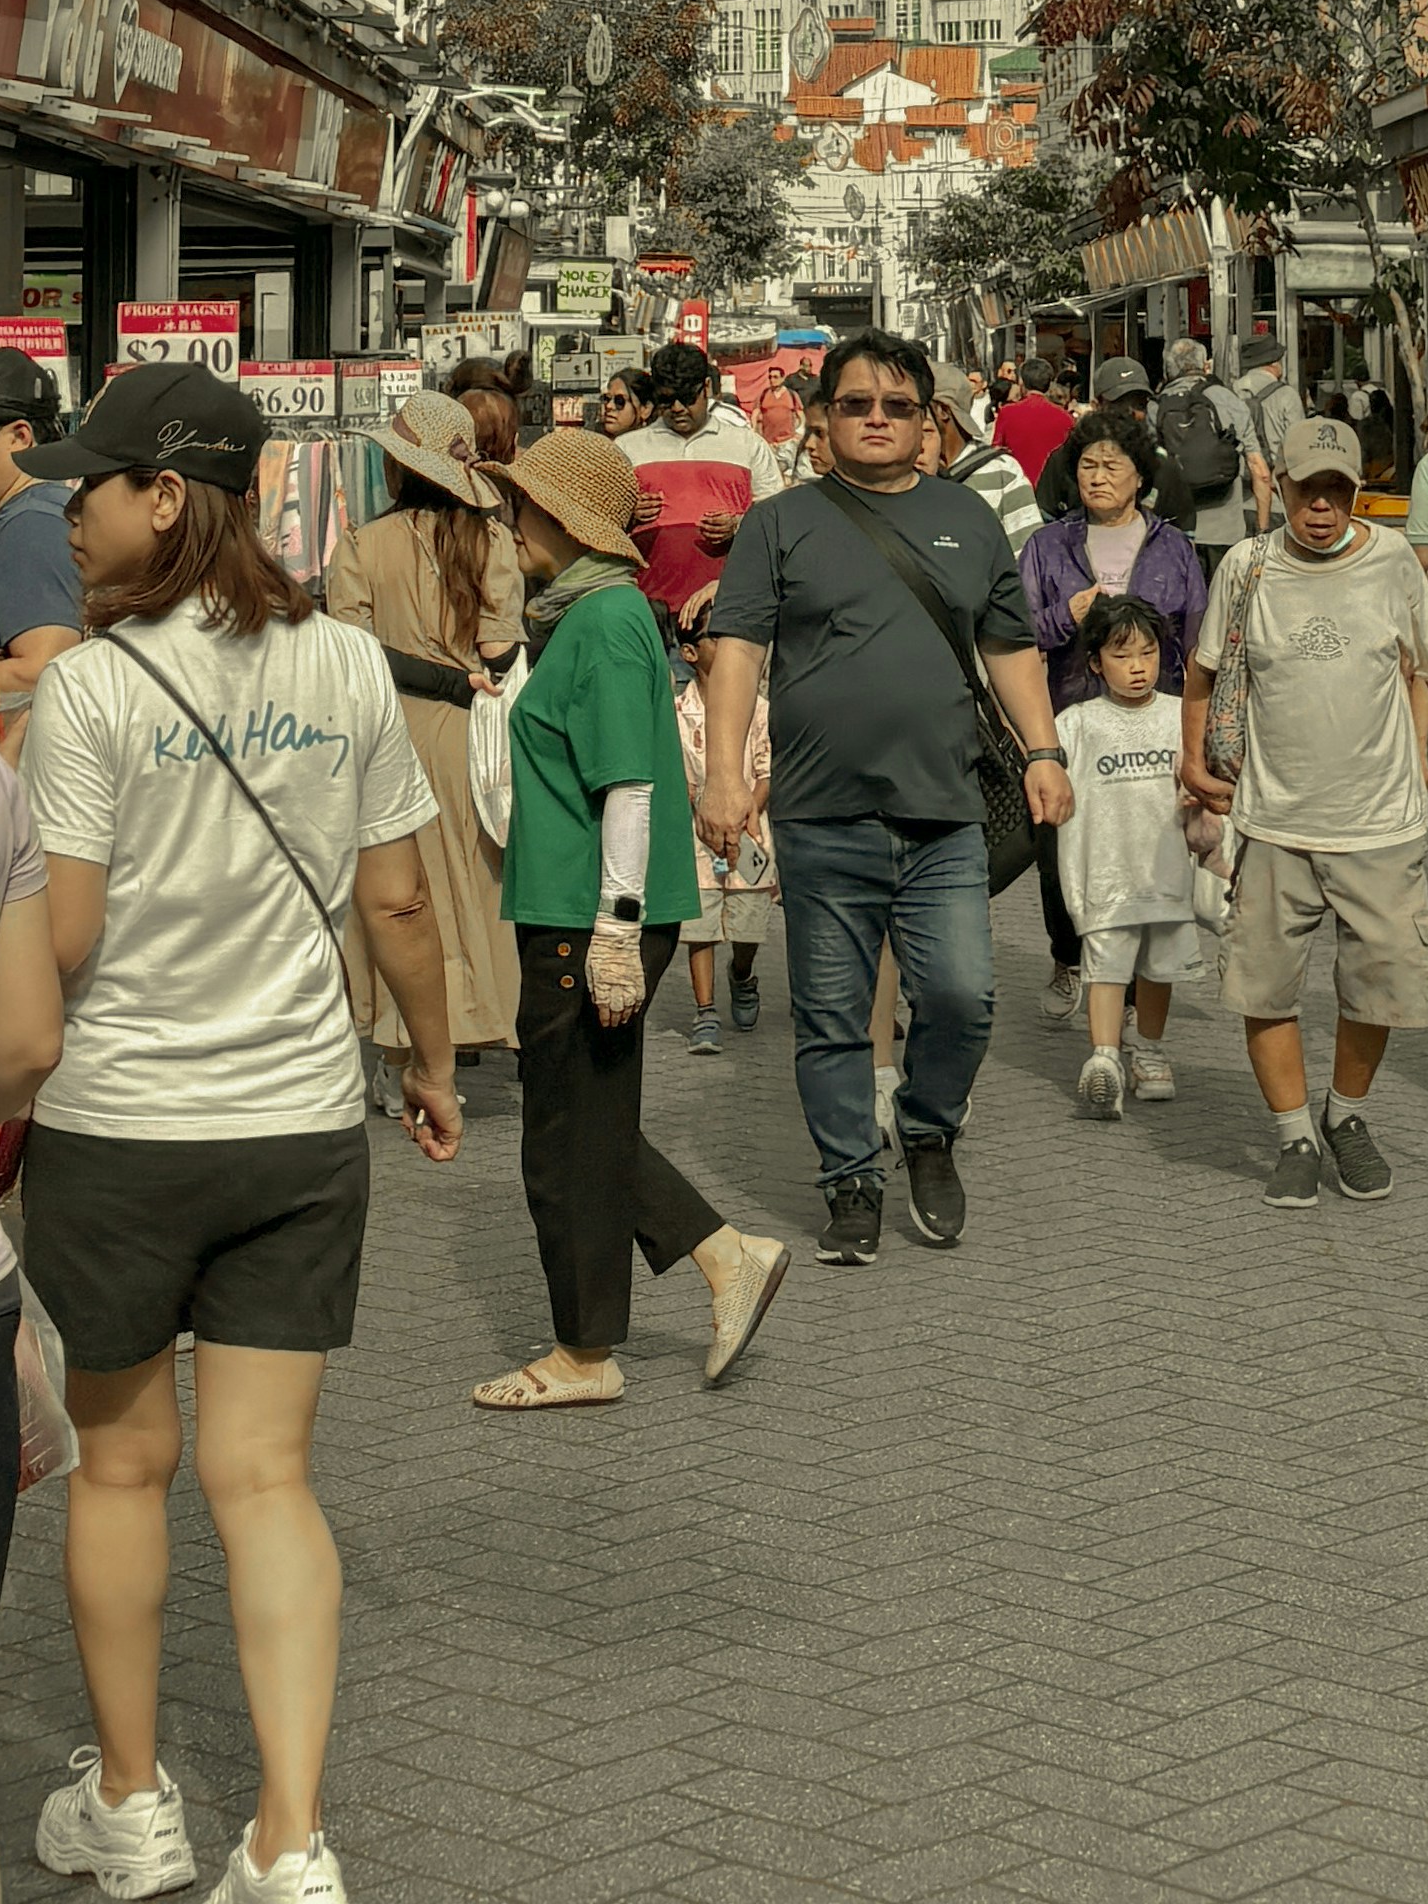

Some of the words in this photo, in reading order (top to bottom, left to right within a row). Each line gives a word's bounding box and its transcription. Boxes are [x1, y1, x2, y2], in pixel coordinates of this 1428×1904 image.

[558, 269, 610, 284] MONEY
[23, 287, 62, 309] OR
[557, 285, 611, 299] CHANGER
[124, 304, 176, 317] FRIDGE
[178, 303, 236, 316] MAGNET
[126, 338, 234, 374] $200
